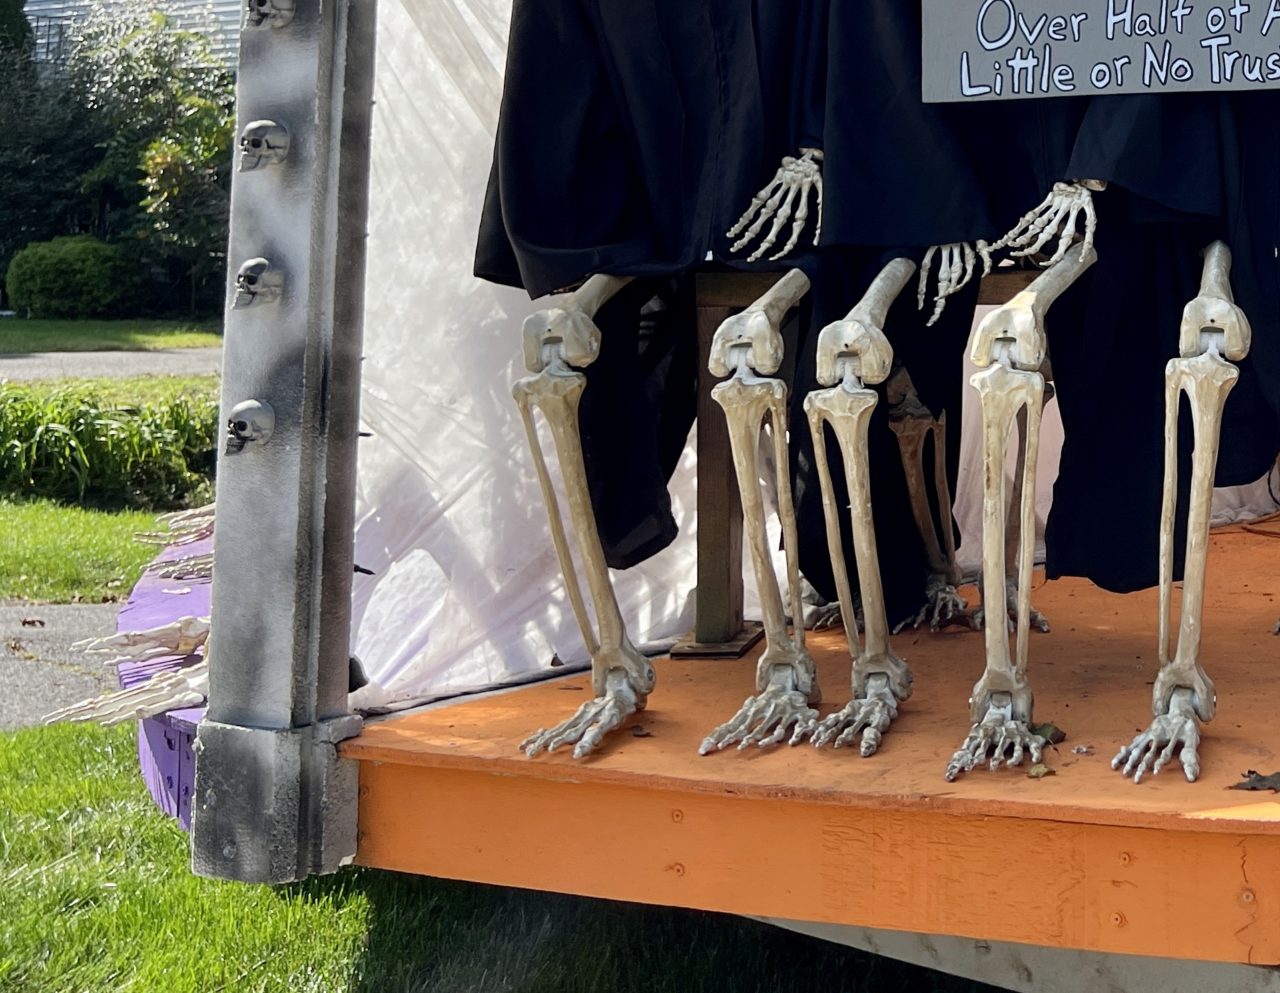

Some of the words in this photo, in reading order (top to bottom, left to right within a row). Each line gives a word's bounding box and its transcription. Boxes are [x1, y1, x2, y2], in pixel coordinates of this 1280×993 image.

[960, 44, 1075, 97] Little
[1090, 56, 1130, 89] or
[1143, 42, 1192, 86] No
